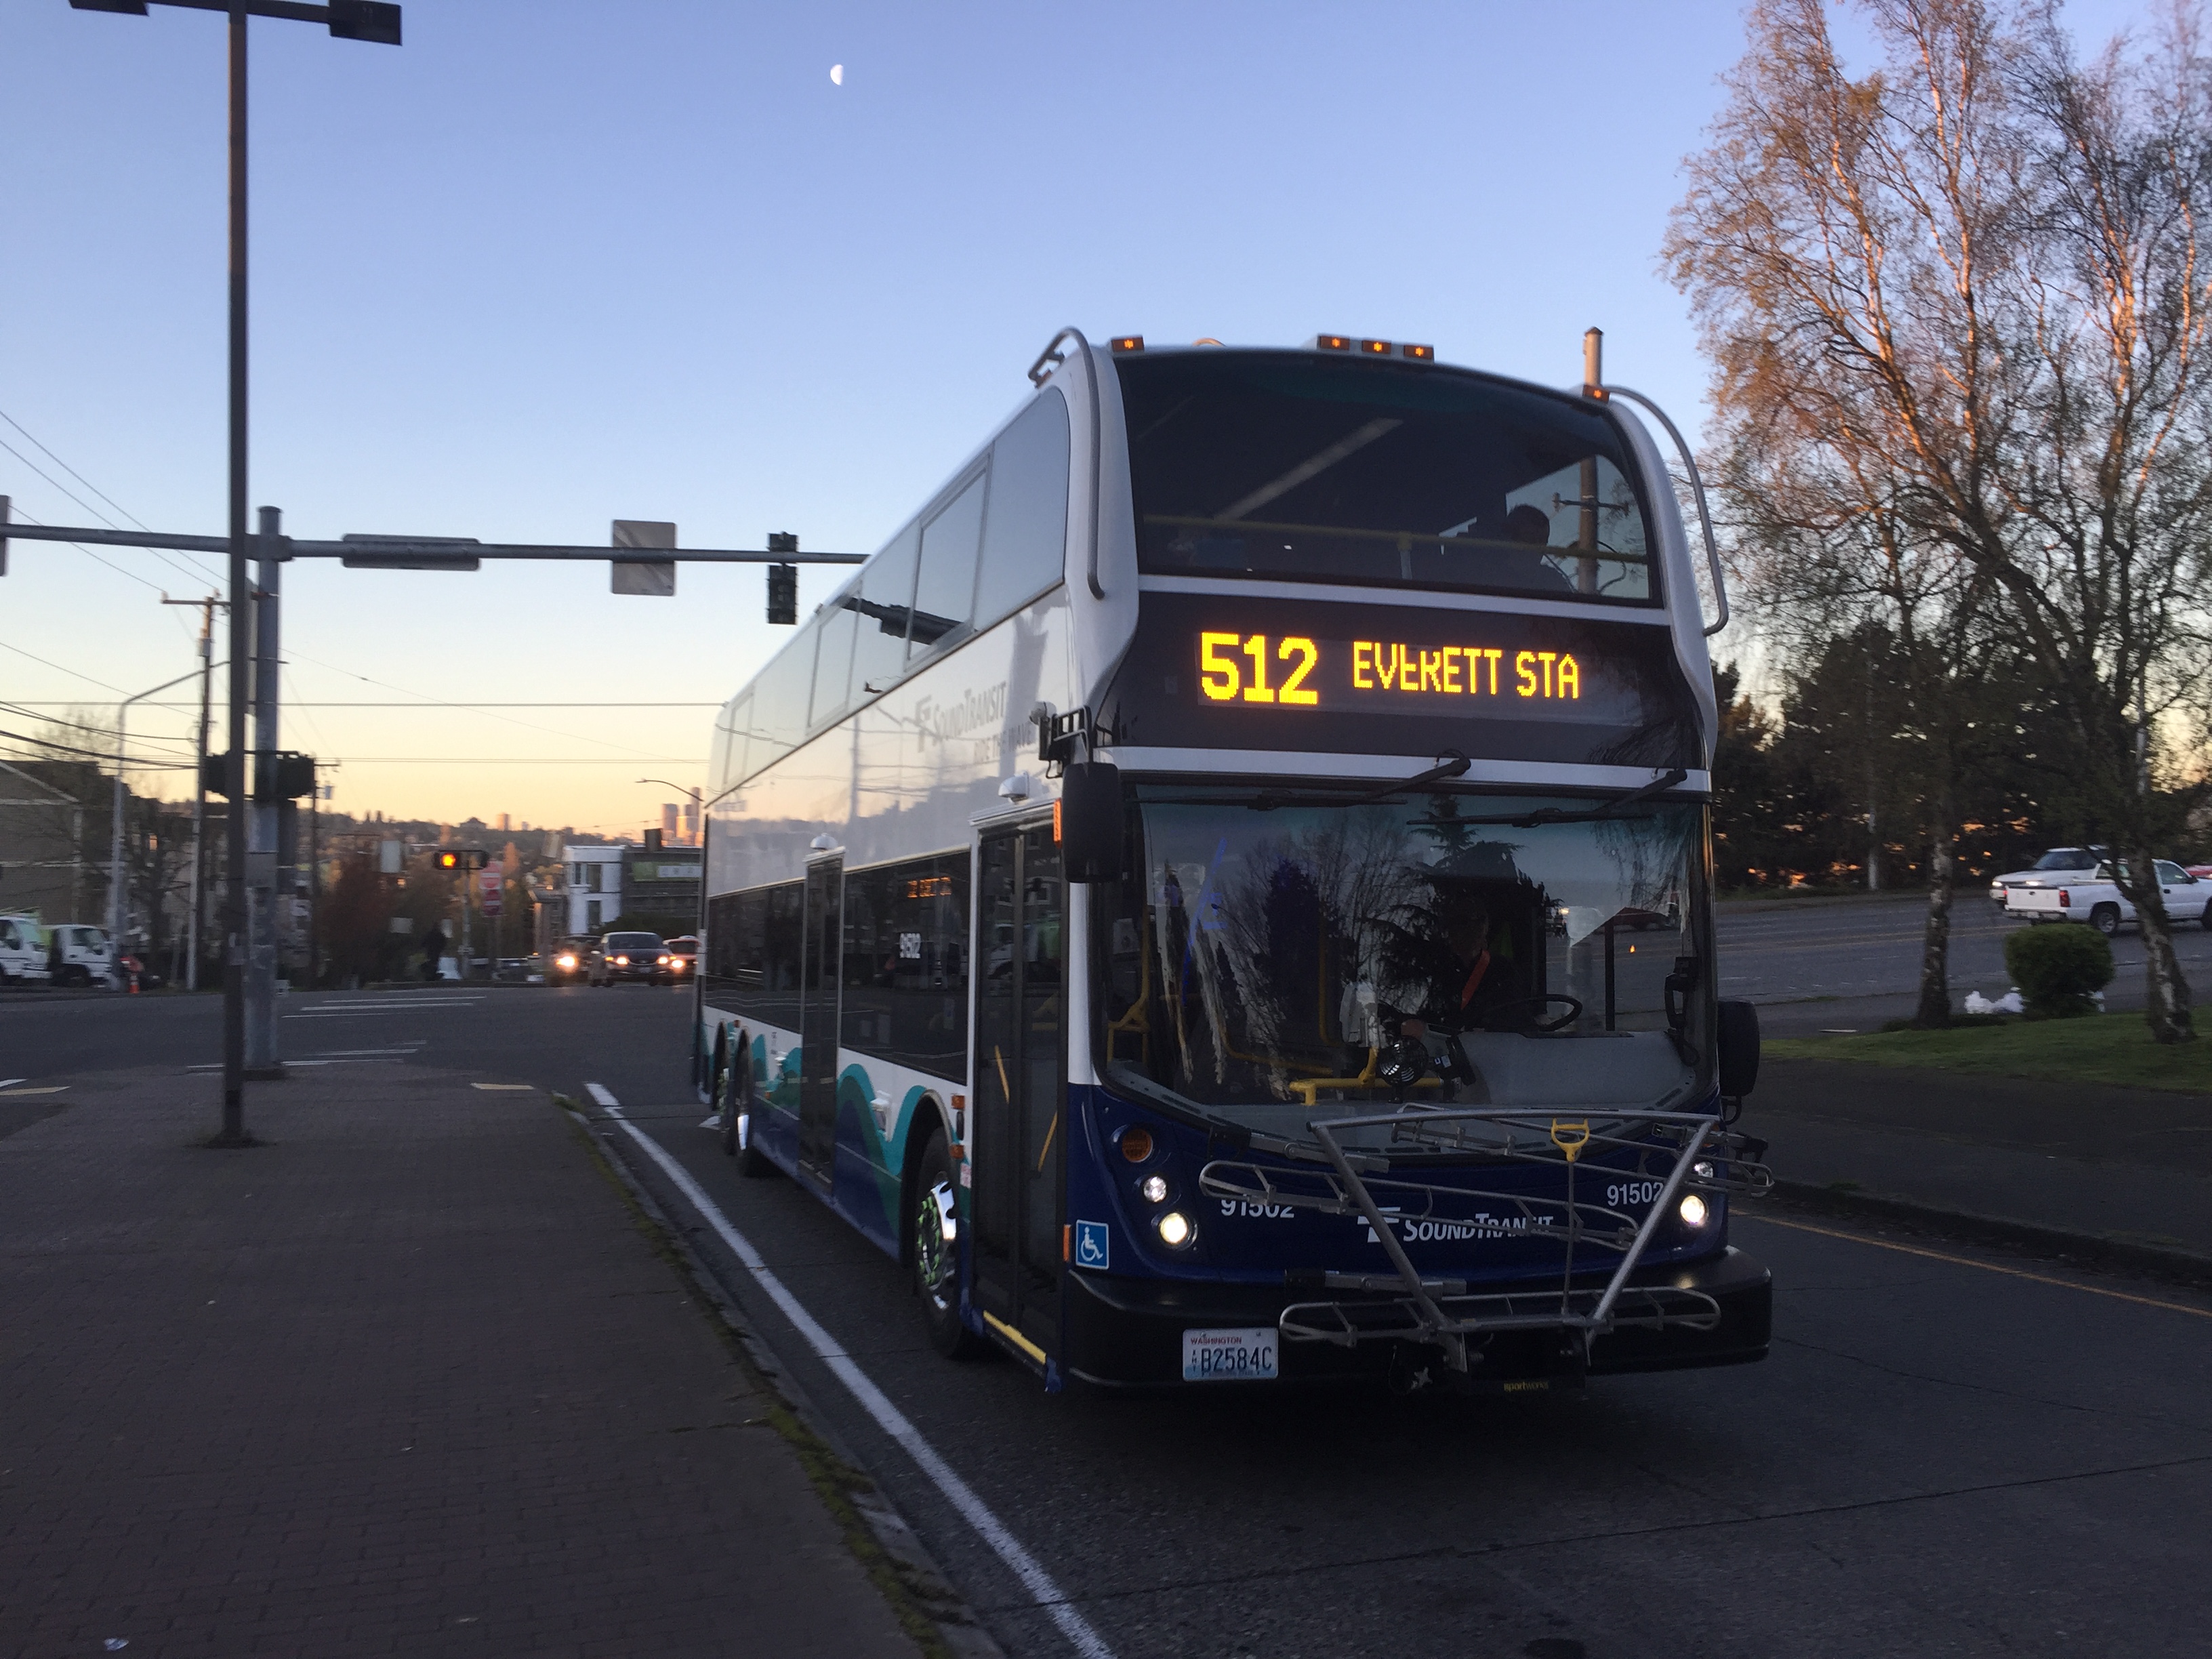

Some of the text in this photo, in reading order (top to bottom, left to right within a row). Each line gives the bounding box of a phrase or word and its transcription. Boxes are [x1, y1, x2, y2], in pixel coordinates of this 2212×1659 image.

[1200, 631, 1580, 705] 512 EVERETT STA
[1607, 1181, 1664, 1207] 91502
[1403, 1212, 1554, 1242] SOUNDTRANIT
[1191, 1336, 1242, 1345] WASHINGTON
[1201, 1346, 1272, 1373] B2584C
